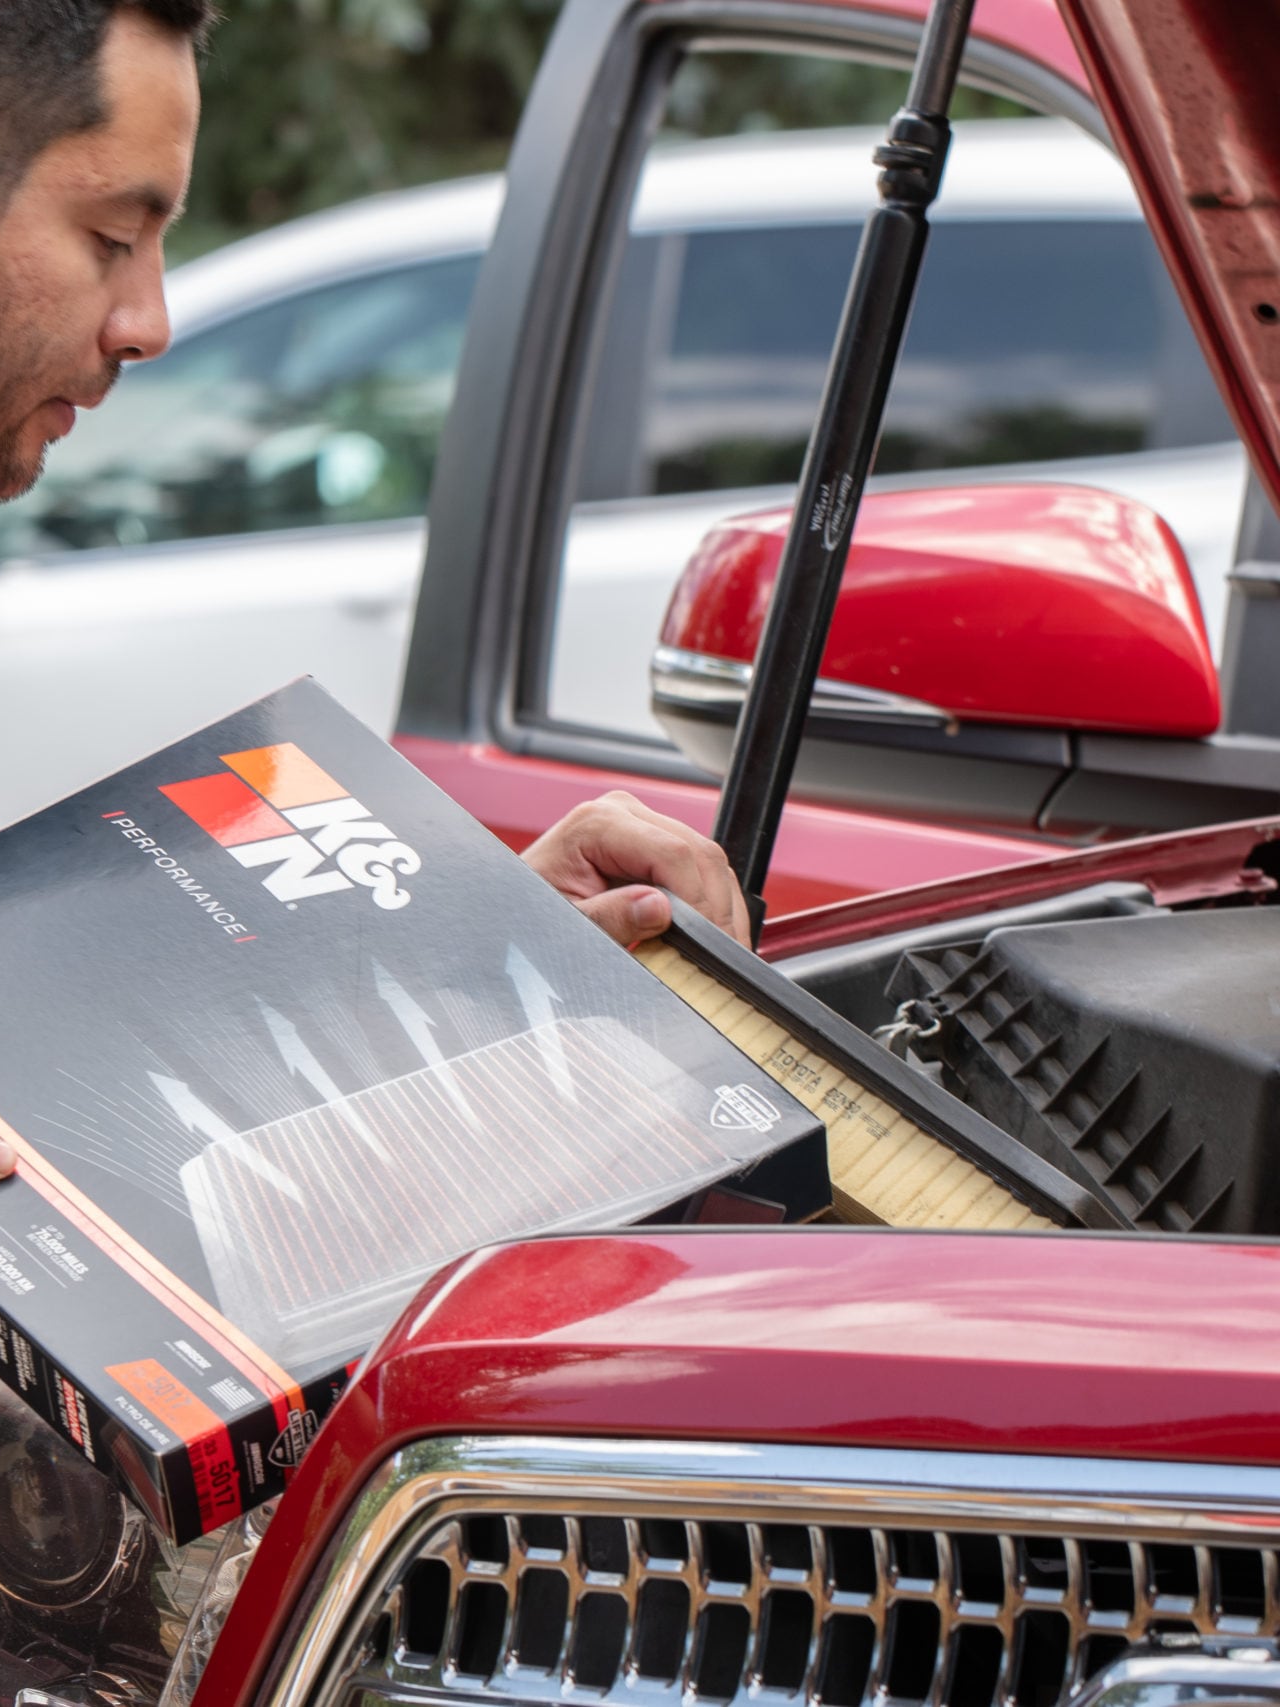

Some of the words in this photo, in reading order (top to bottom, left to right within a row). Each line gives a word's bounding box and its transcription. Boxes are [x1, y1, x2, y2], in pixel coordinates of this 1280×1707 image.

[110, 816, 248, 936] PERFORMANCE
[775, 1048, 822, 1086] TOYOTA
[60, 1251, 89, 1274] MILES
[15, 1277, 37, 1292] KM
[114, 1395, 144, 1421] FILTRO
[138, 1417, 155, 1431] DE
[148, 1428, 171, 1446] AIRE
